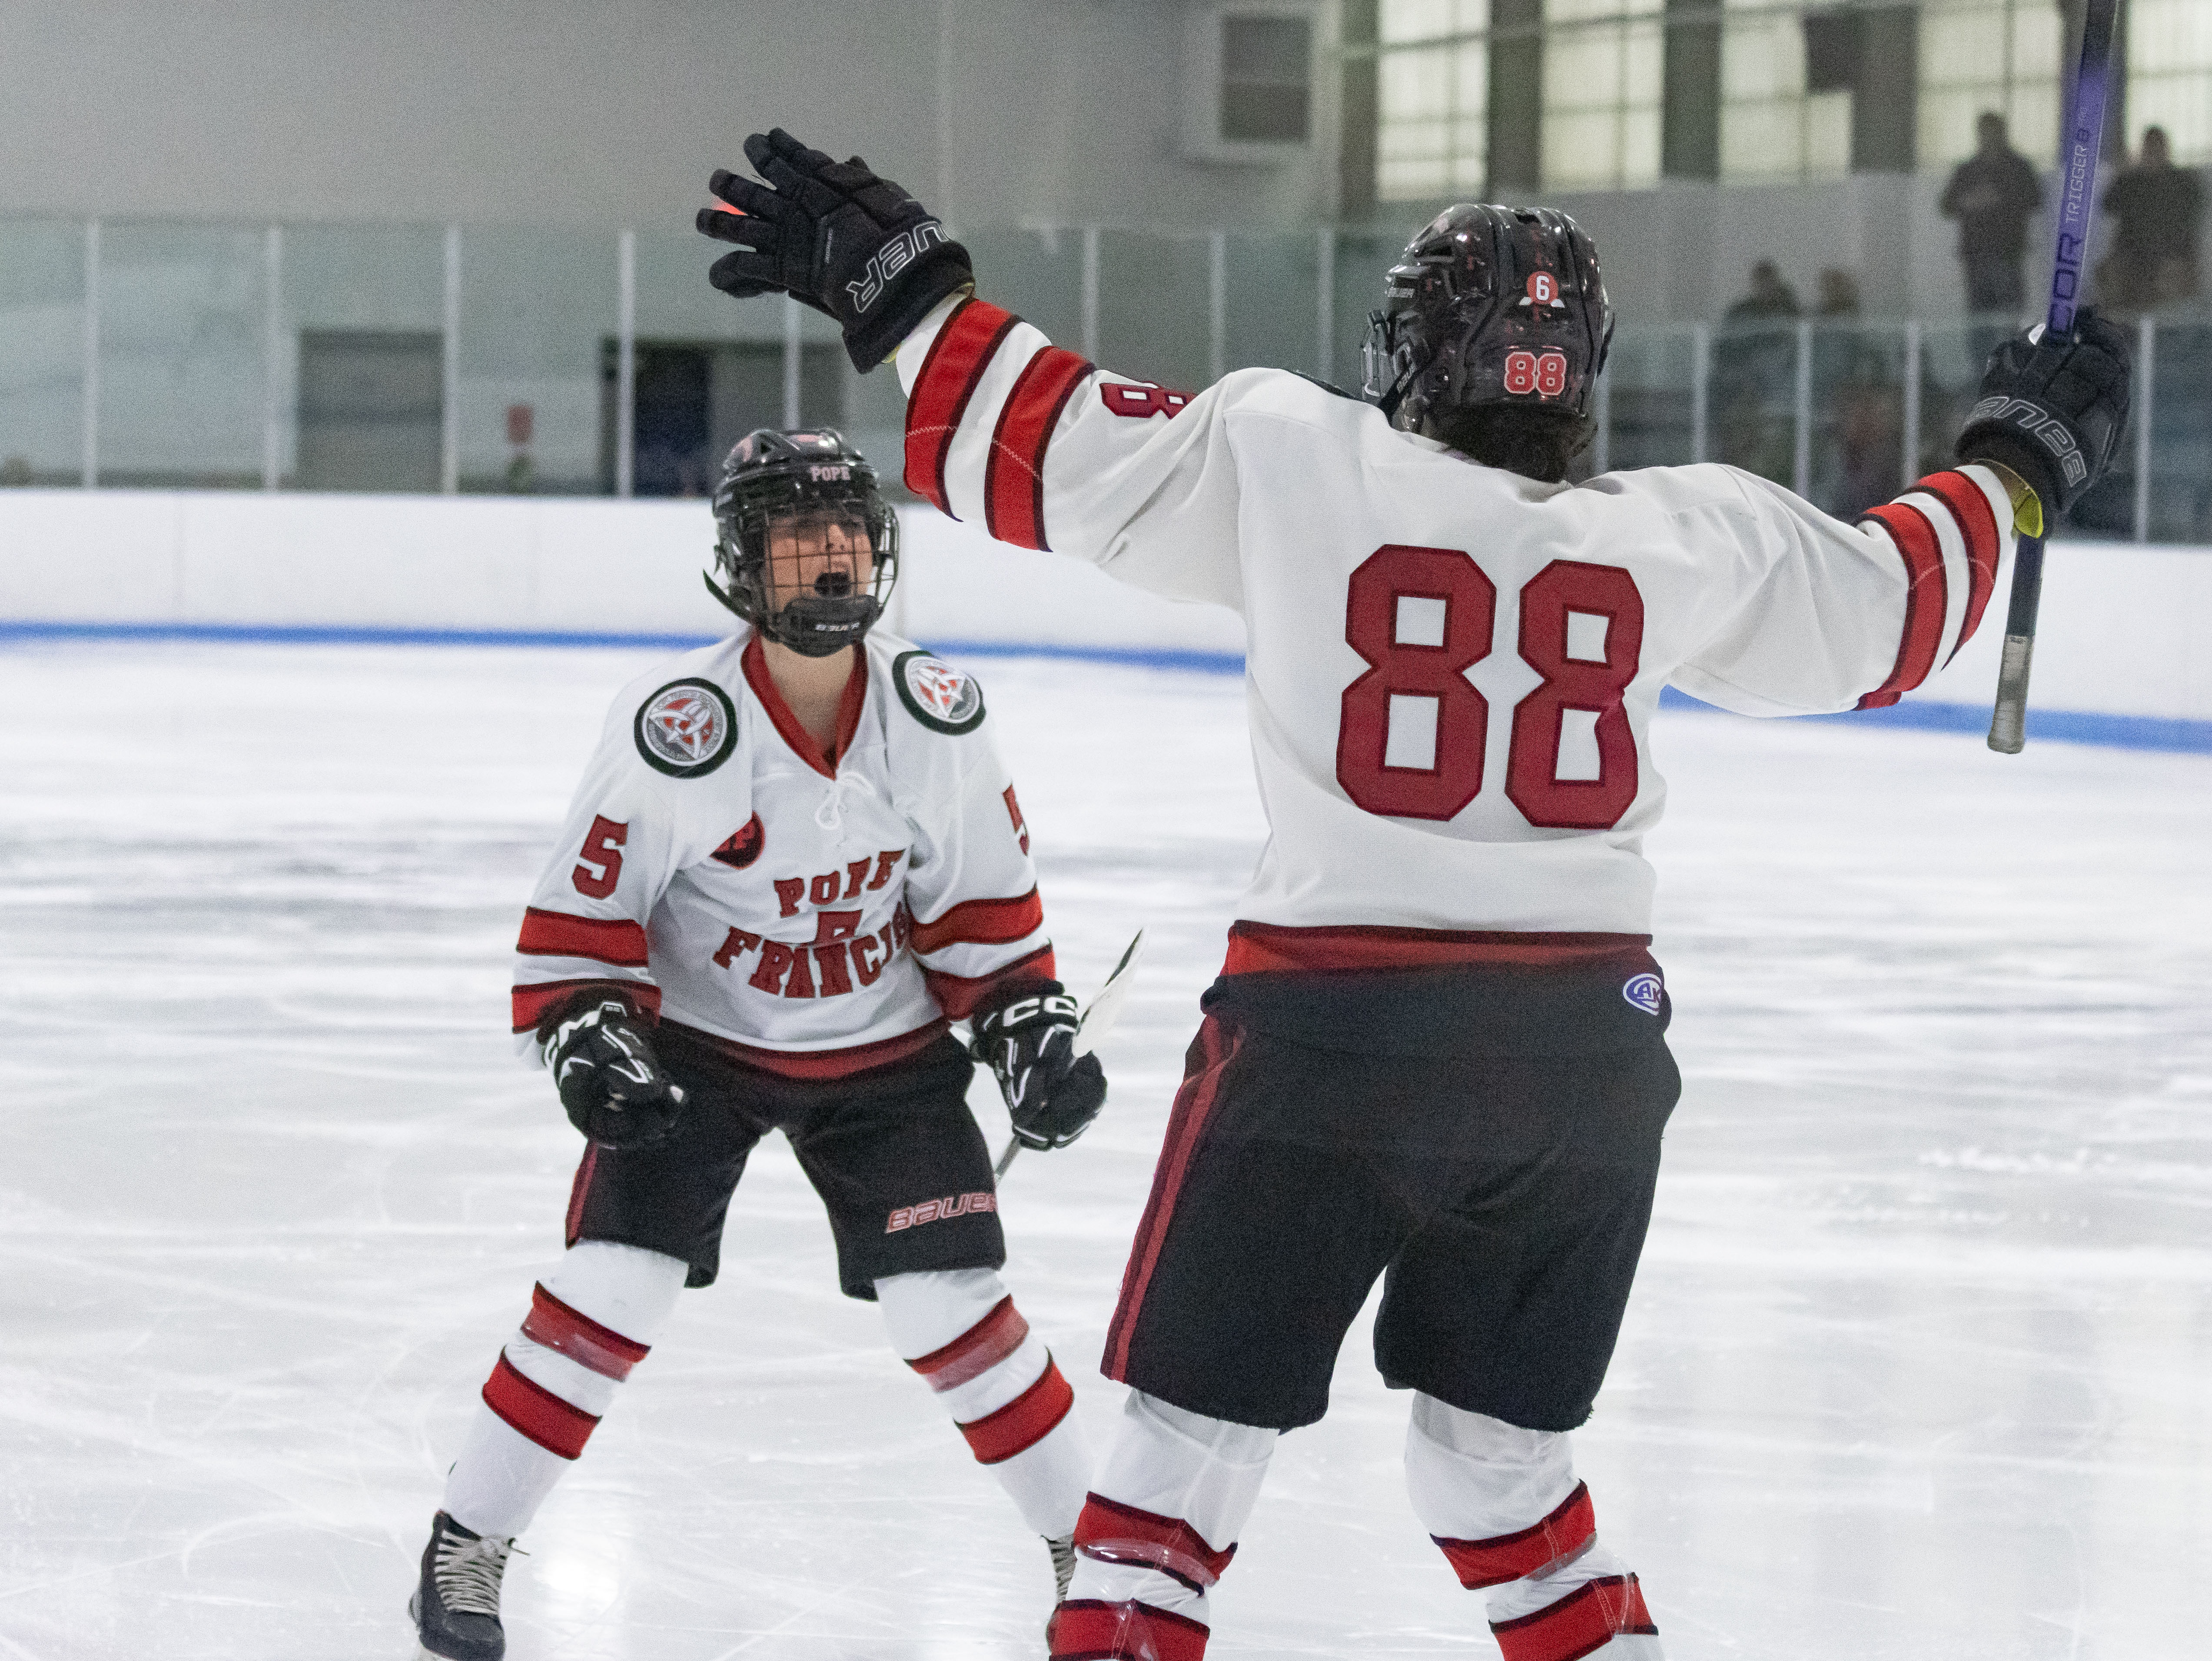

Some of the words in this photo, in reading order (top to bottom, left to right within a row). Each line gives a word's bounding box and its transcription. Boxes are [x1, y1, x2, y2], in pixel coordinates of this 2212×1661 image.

[2065, 145, 2088, 224] TRIGGER
[1535, 275, 1550, 301] 6
[1504, 351, 1566, 396] 88
[810, 466, 851, 482] POPE
[1336, 544, 1644, 830] 88
[571, 813, 628, 900] 5
[773, 849, 906, 918] POPE
